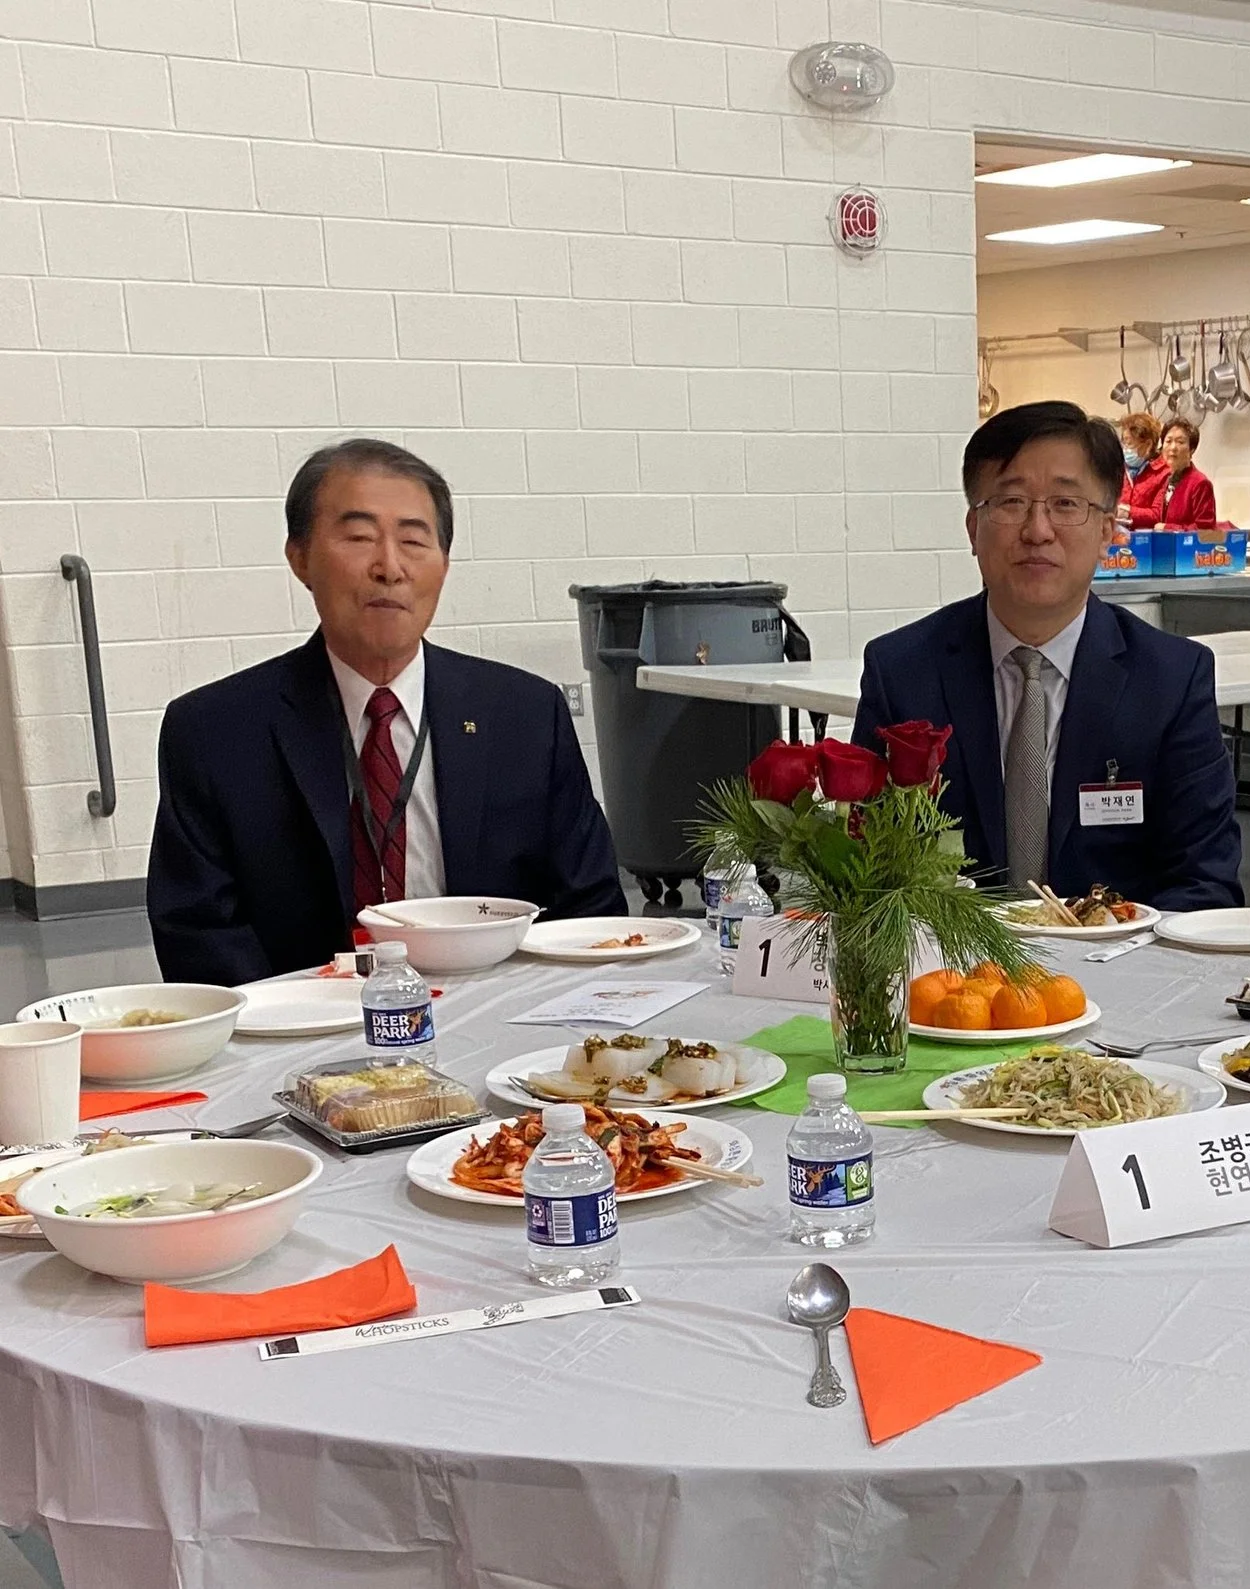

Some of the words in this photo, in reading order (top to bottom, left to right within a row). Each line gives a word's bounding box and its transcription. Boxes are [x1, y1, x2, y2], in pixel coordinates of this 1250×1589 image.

[752, 617, 780, 633] BRUT
[758, 938, 772, 977] 1
[372, 1015, 410, 1026] DEER
[373, 1026, 412, 1039] PARK
[789, 1164, 807, 1182] ER
[1122, 1154, 1151, 1210] 1
[790, 1178, 808, 1196] RK
[598, 1192, 616, 1215] DE
[599, 1207, 617, 1229] PA
